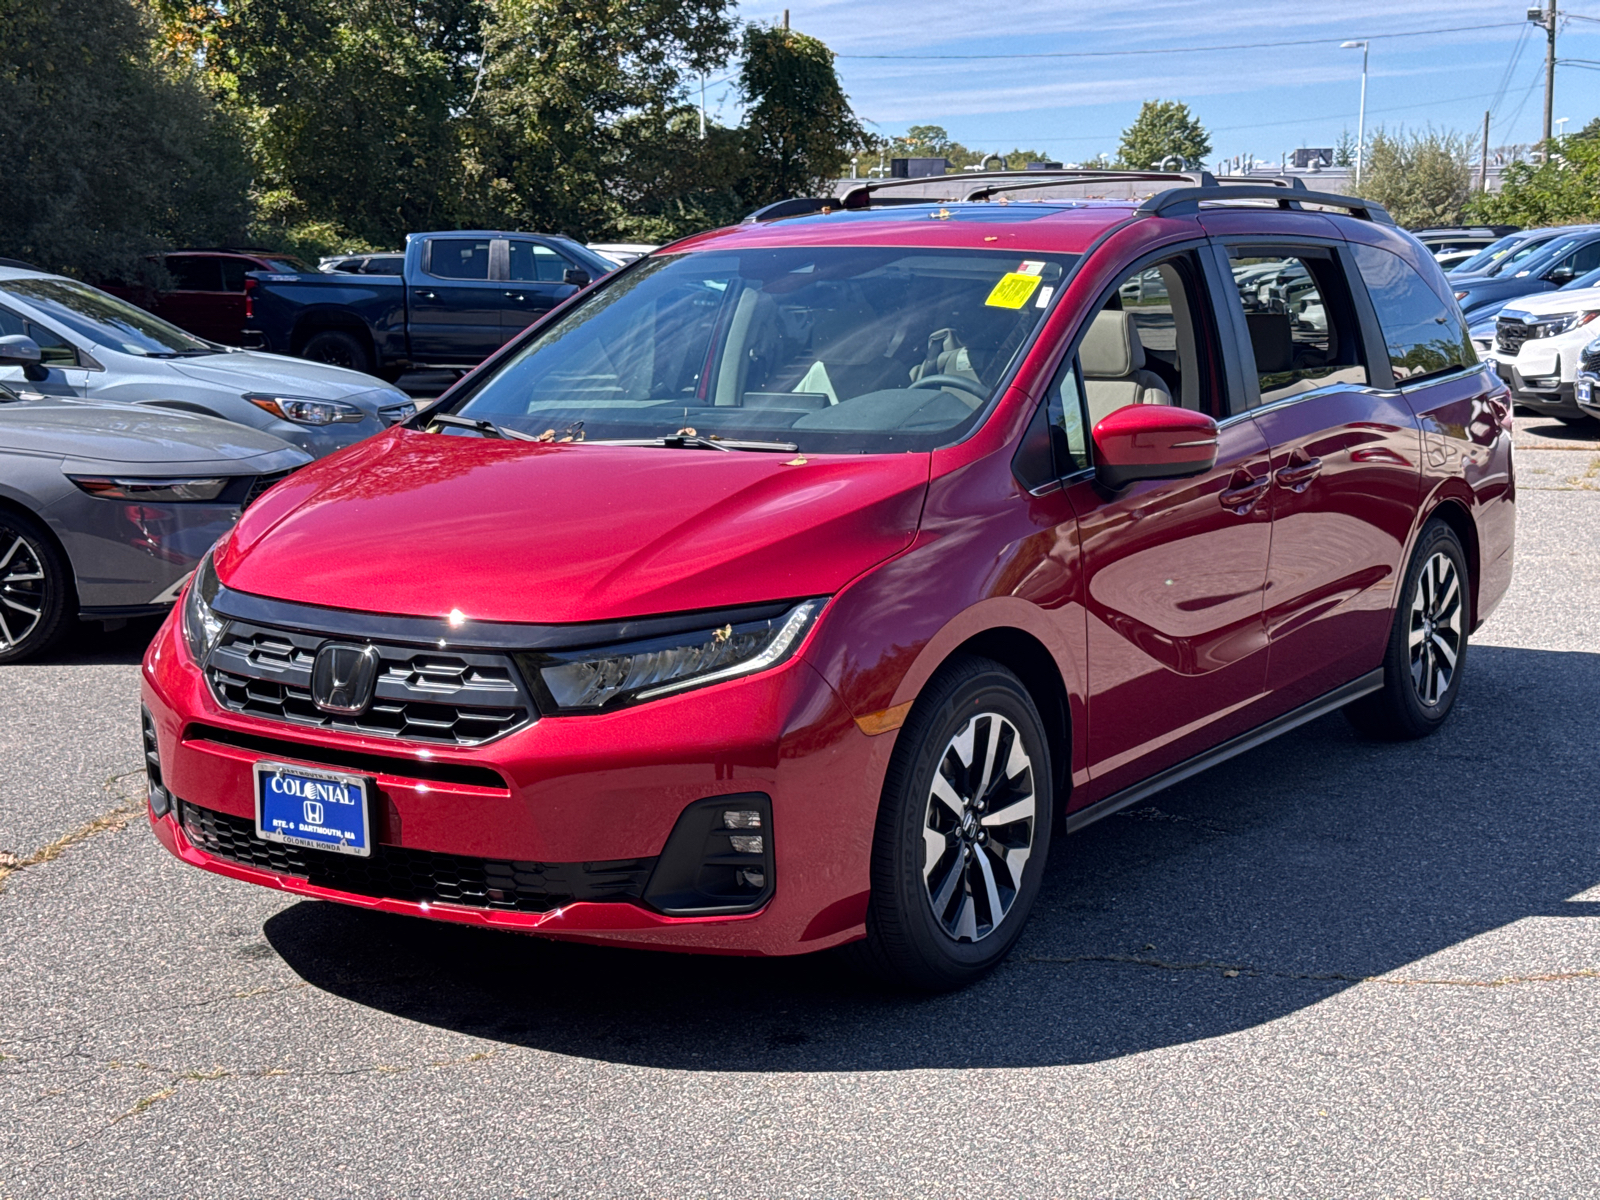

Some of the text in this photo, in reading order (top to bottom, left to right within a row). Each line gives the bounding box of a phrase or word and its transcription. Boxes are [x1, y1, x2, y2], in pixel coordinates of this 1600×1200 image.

[271, 777, 355, 805] COLONIAL
[272, 819, 288, 828] RTE.
[299, 823, 343, 838] DARTMOUTH,
[344, 831, 355, 840] MA
[904, 767, 923, 905] TURANZA
[283, 836, 341, 852] COLONIAL HONDA
